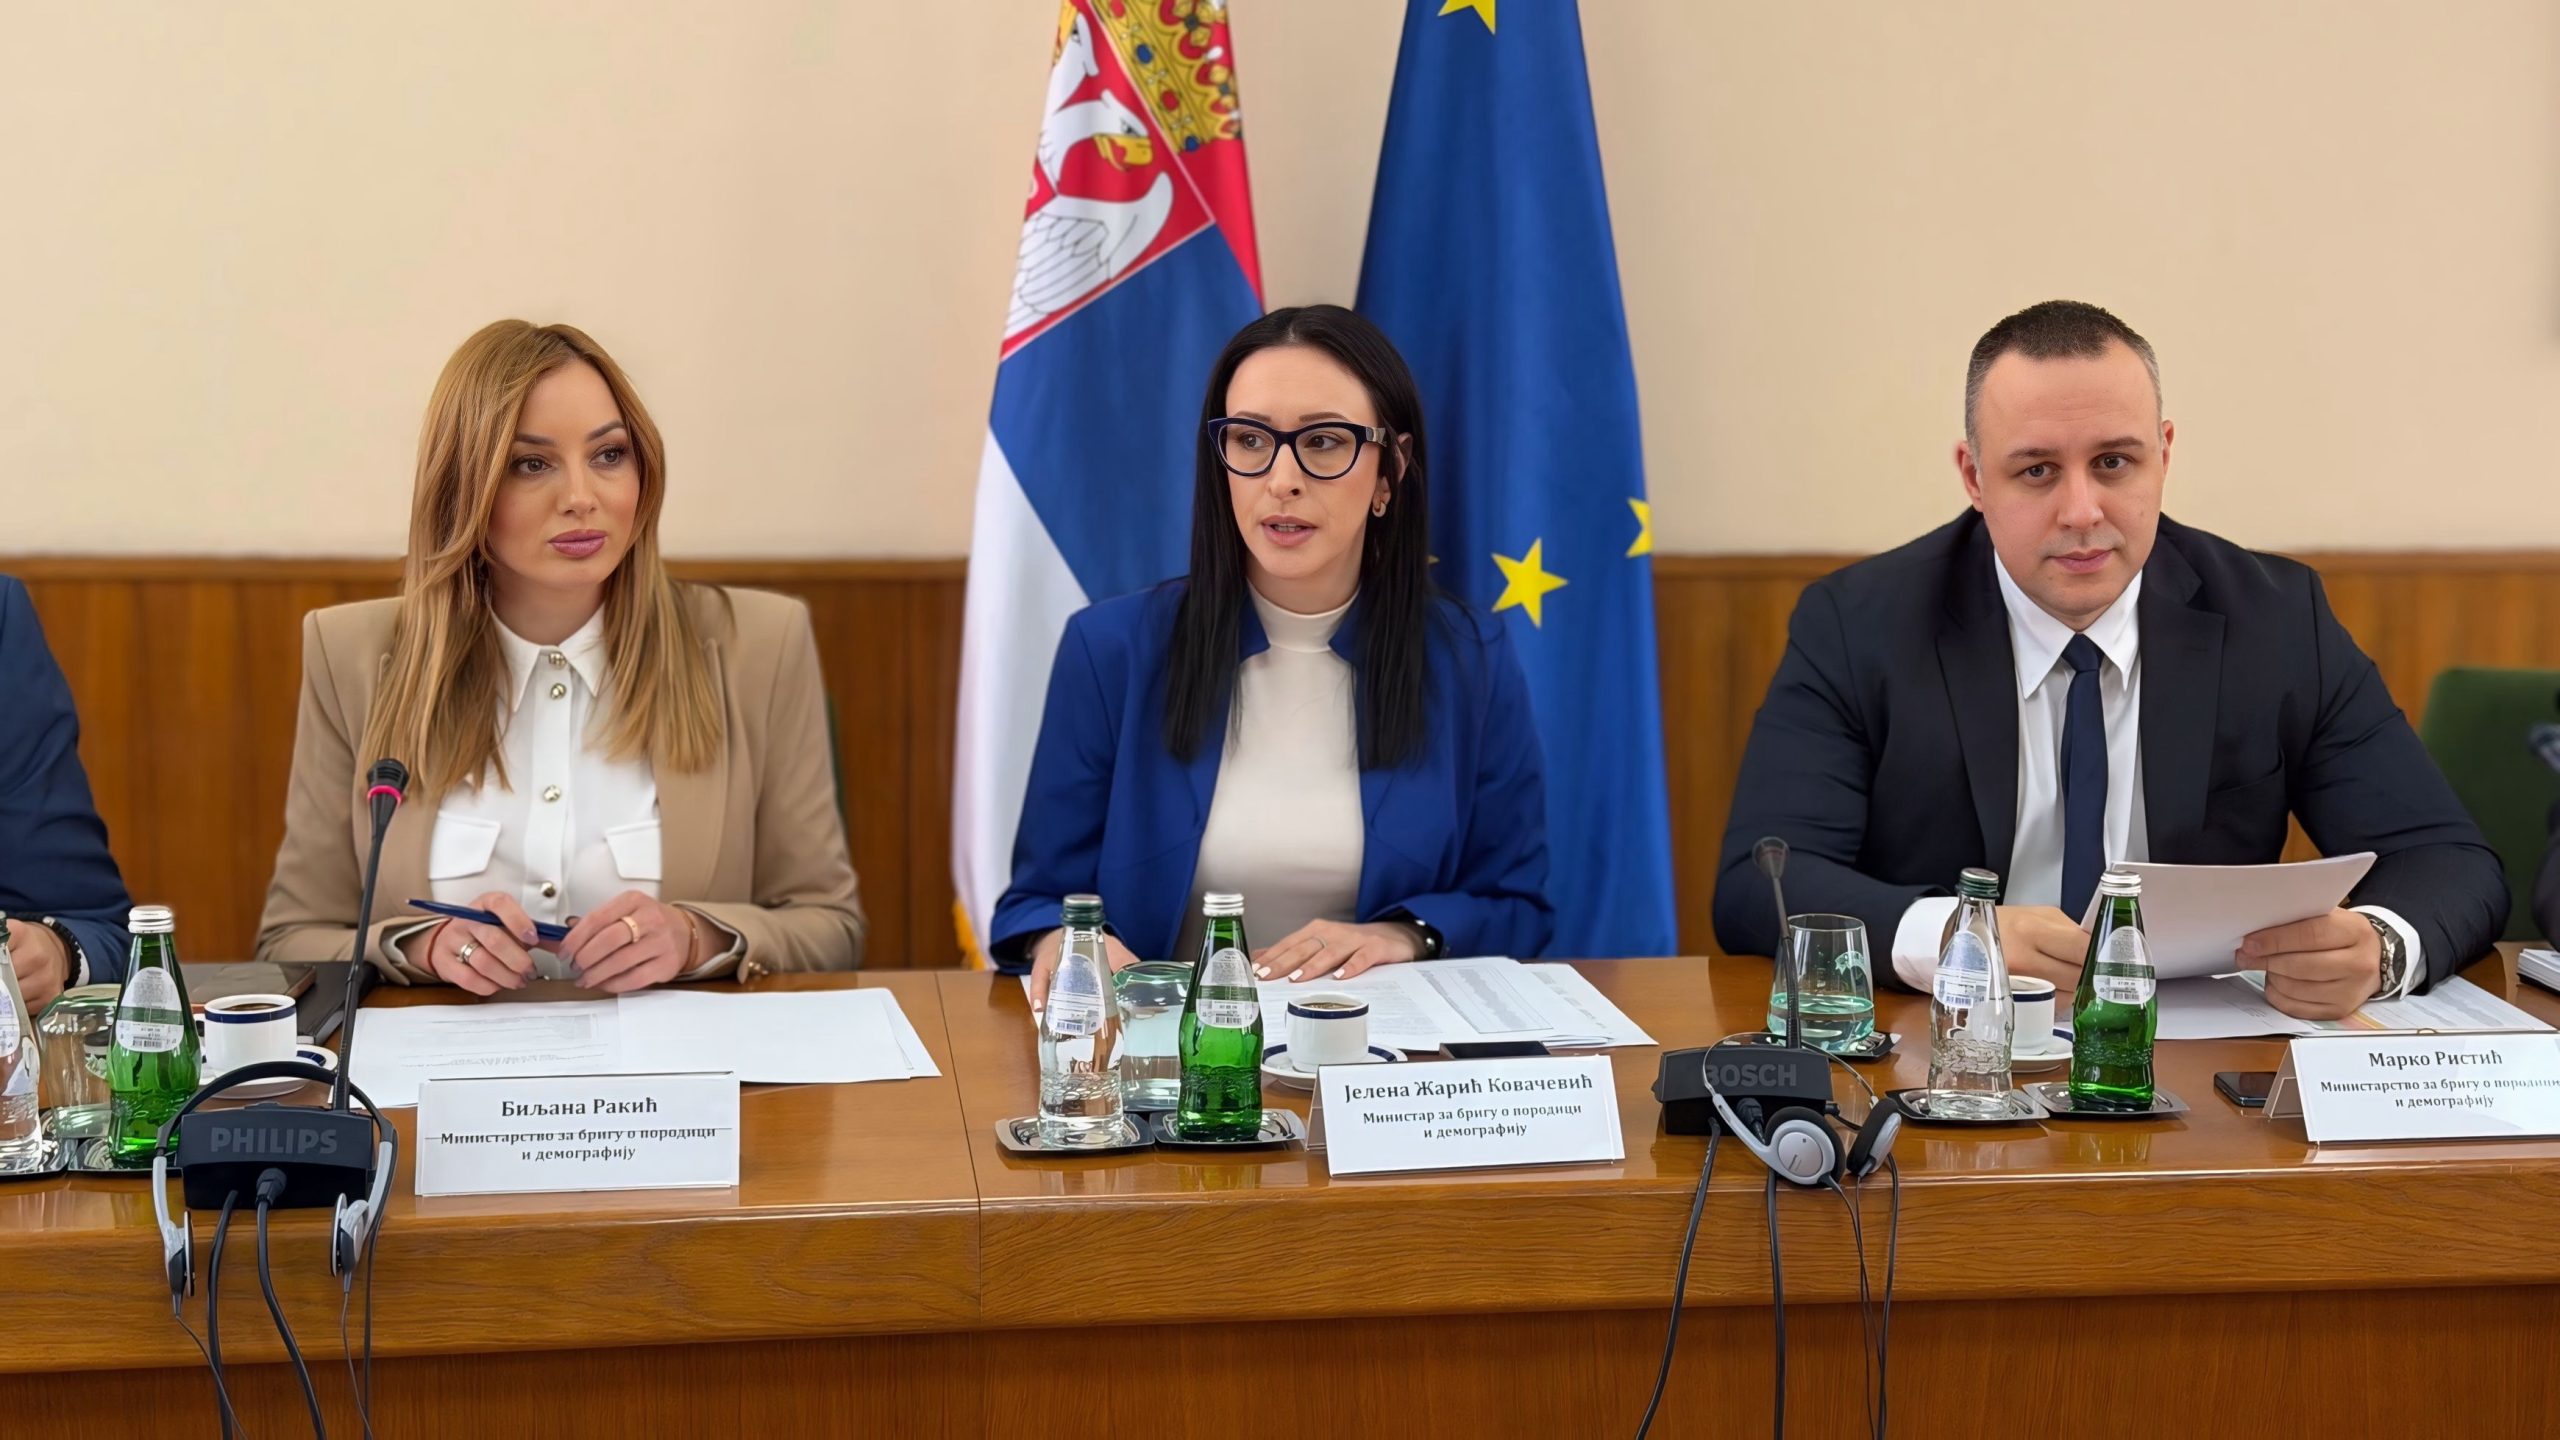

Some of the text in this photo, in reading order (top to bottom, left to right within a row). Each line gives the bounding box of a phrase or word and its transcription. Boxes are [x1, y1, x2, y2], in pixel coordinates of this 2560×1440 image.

[2369, 1049, 2503, 1070] Марко Ристић
[1705, 1063, 1798, 1088] BOSCH
[2321, 1080, 2420, 1094] Министарство
[2422, 1080, 2437, 1090] за
[2440, 1077, 2480, 1093] бригу
[2483, 1079, 2491, 1089] о
[1344, 1073, 1593, 1103] Јелена Жарић Ковачевић
[501, 1096, 658, 1118] Биљана Ракић
[2395, 1094, 2495, 1110] и демографију
[1363, 1103, 1582, 1125] Министар за бригу о породици
[210, 1126, 338, 1155] PHILIPS
[440, 1127, 717, 1146] Министарство за бригу о породици
[1424, 1122, 1527, 1140] и демографију
[521, 1146, 636, 1163] и демографију
